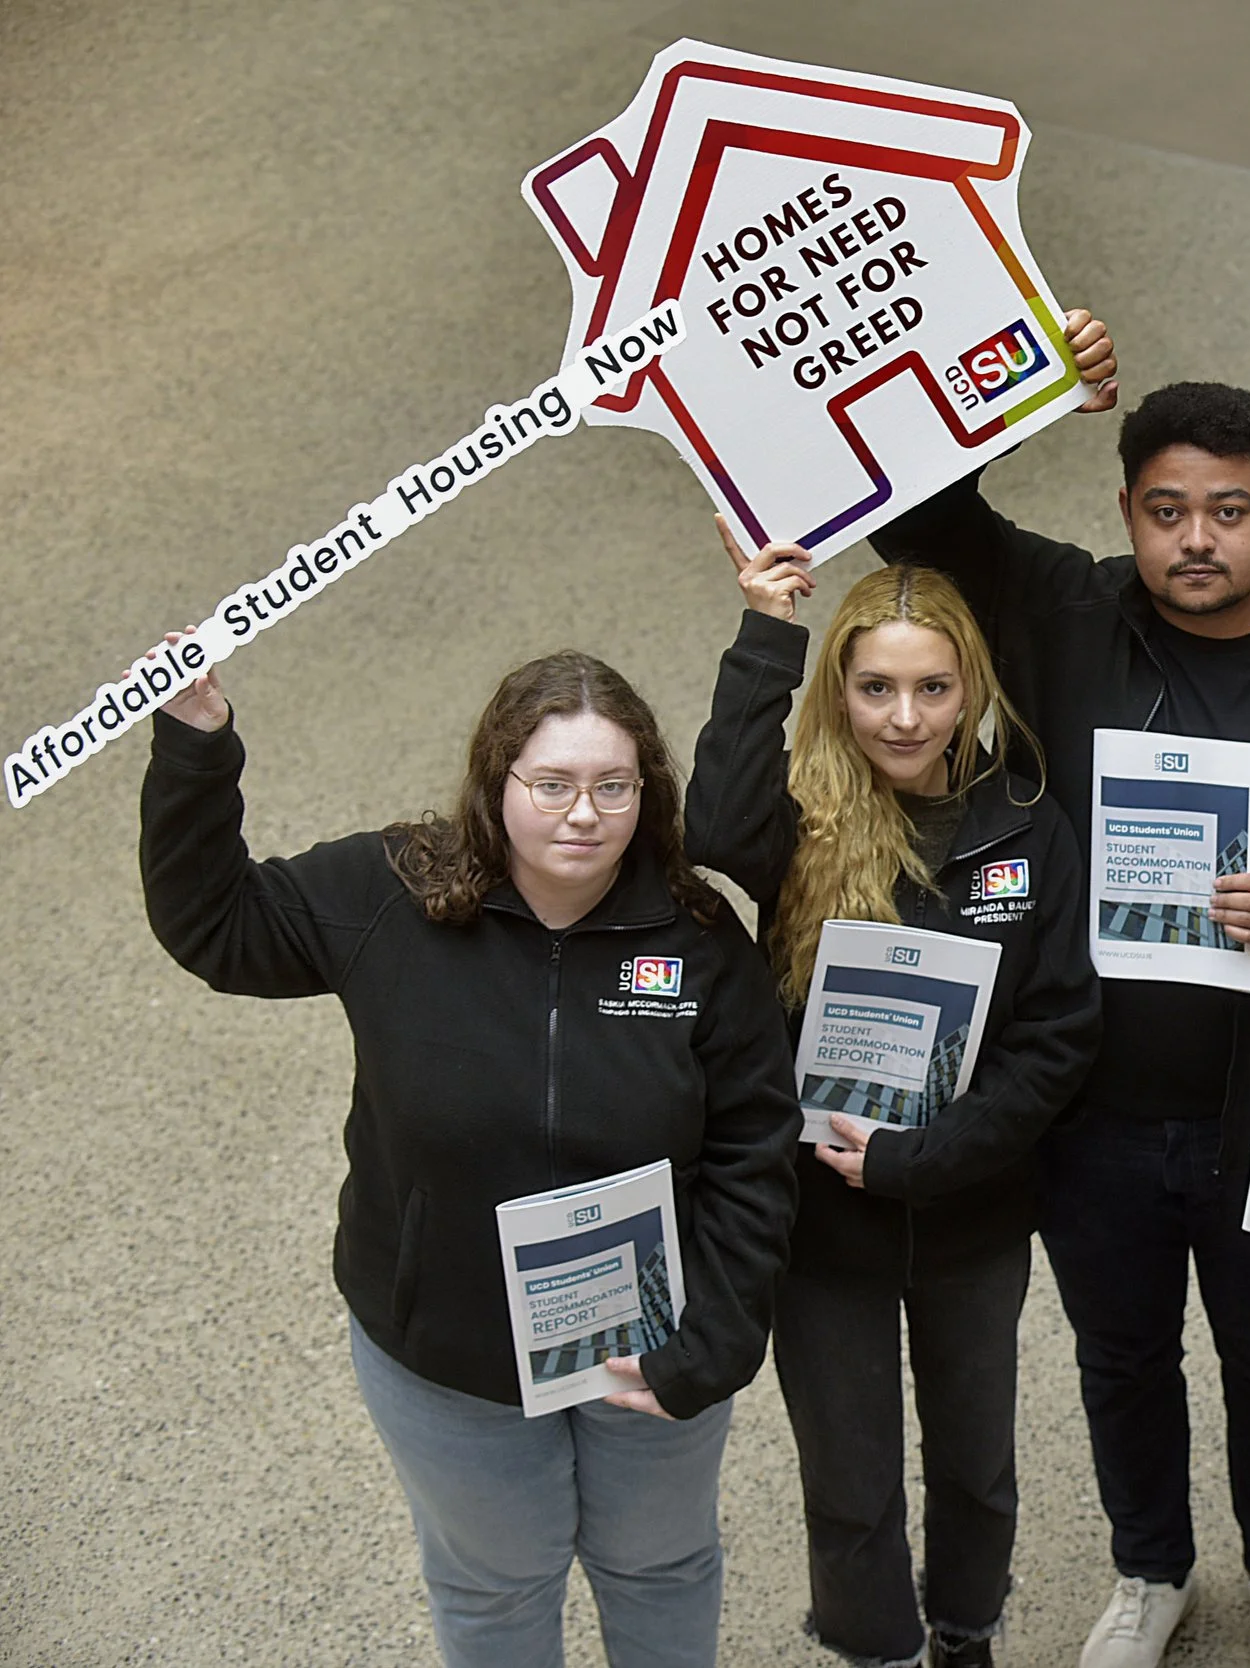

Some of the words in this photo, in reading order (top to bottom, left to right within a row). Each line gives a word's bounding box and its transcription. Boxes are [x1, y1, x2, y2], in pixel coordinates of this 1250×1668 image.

[702, 173, 852, 283] HOMES
[706, 267, 800, 334] FOR
[799, 197, 907, 279] NEED
[741, 294, 836, 368] NOT
[838, 241, 929, 310] FOR
[793, 297, 923, 390] GREED
[945, 371, 980, 411] UCD
[967, 327, 1038, 392] SU
[11, 641, 206, 798] Affordable
[223, 513, 382, 637] Student
[397, 386, 573, 515] Housing
[585, 308, 678, 386] Now
[1163, 755, 1187, 771] SU
[1109, 824, 1127, 833] UCD
[1130, 825, 1172, 835] Students'
[1173, 828, 1200, 837] Union
[1106, 842, 1156, 854] STUDENT
[1106, 856, 1211, 872] ACCOMMODATION
[969, 870, 981, 900] UCD
[986, 865, 1024, 893] SU
[1106, 869, 1174, 885] REPORT
[960, 902, 1004, 916] MIRANDA
[974, 912, 1024, 925] PRESIDENT
[894, 949, 919, 964] SU
[618, 961, 632, 991] UCD
[638, 962, 677, 989] SU
[828, 1007, 848, 1016] UCD
[849, 1009, 892, 1021] Students'
[892, 1015, 920, 1026] Union
[822, 1024, 872, 1036] STUDENT
[819, 1035, 925, 1058] ACCOMMODATION
[817, 1047, 885, 1066] REPORT
[576, 1206, 599, 1224] SU
[529, 1281, 549, 1292] UCD
[551, 1269, 593, 1287] Students'
[593, 1261, 619, 1276] Union
[529, 1291, 578, 1309] STUDENT
[531, 1283, 633, 1320] ACCOMMODATION
[533, 1307, 598, 1334] REPORT
